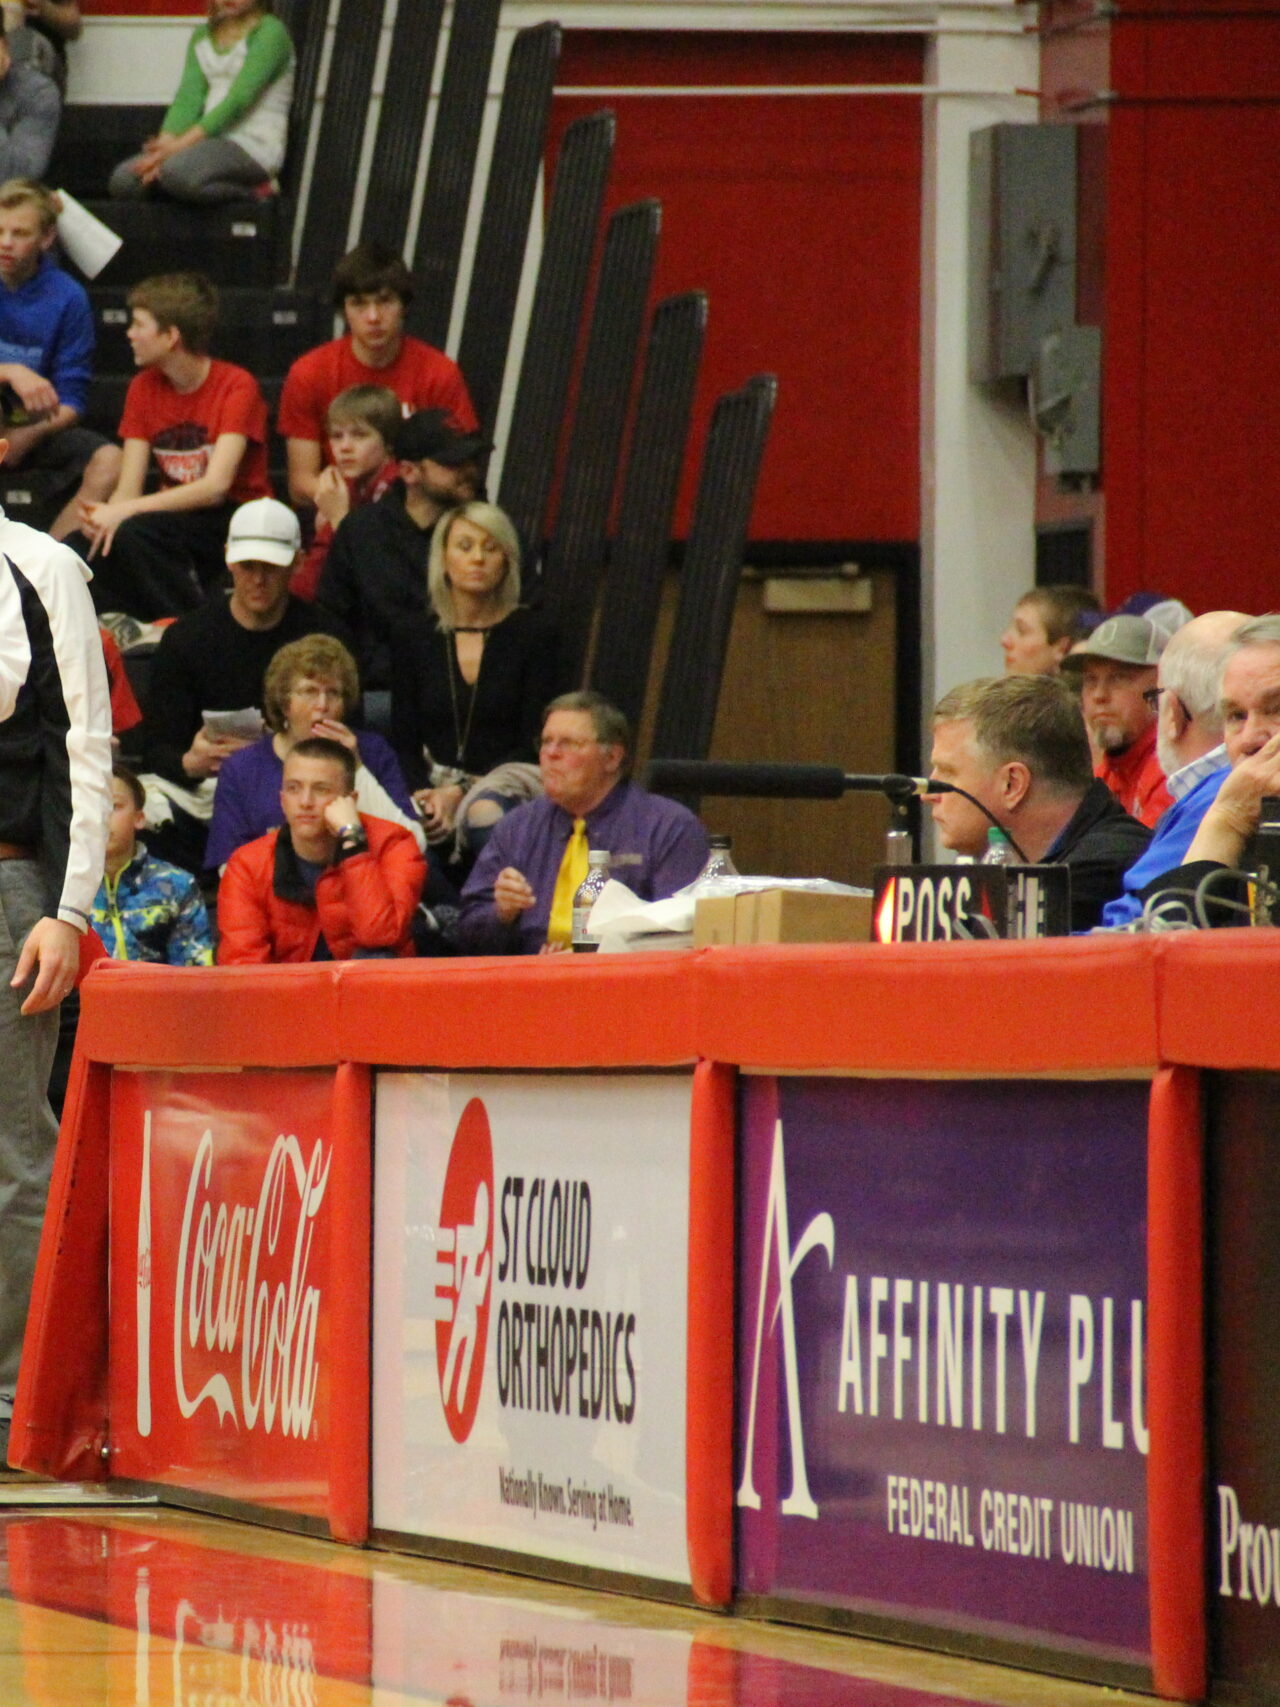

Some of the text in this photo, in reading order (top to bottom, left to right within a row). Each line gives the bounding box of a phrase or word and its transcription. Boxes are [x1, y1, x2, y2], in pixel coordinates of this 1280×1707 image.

[174, 1128, 333, 1441] Coca-Cola
[498, 1176, 593, 1290] ST CLOUD
[496, 1300, 637, 1425] ORTHOPEDICS
[838, 1274, 1151, 1456] AFFINITY PLU
[567, 1476, 598, 1532] Serving
[599, 1486, 608, 1522] at
[887, 1475, 1134, 1574] FEDERAL CREDIT UNION
